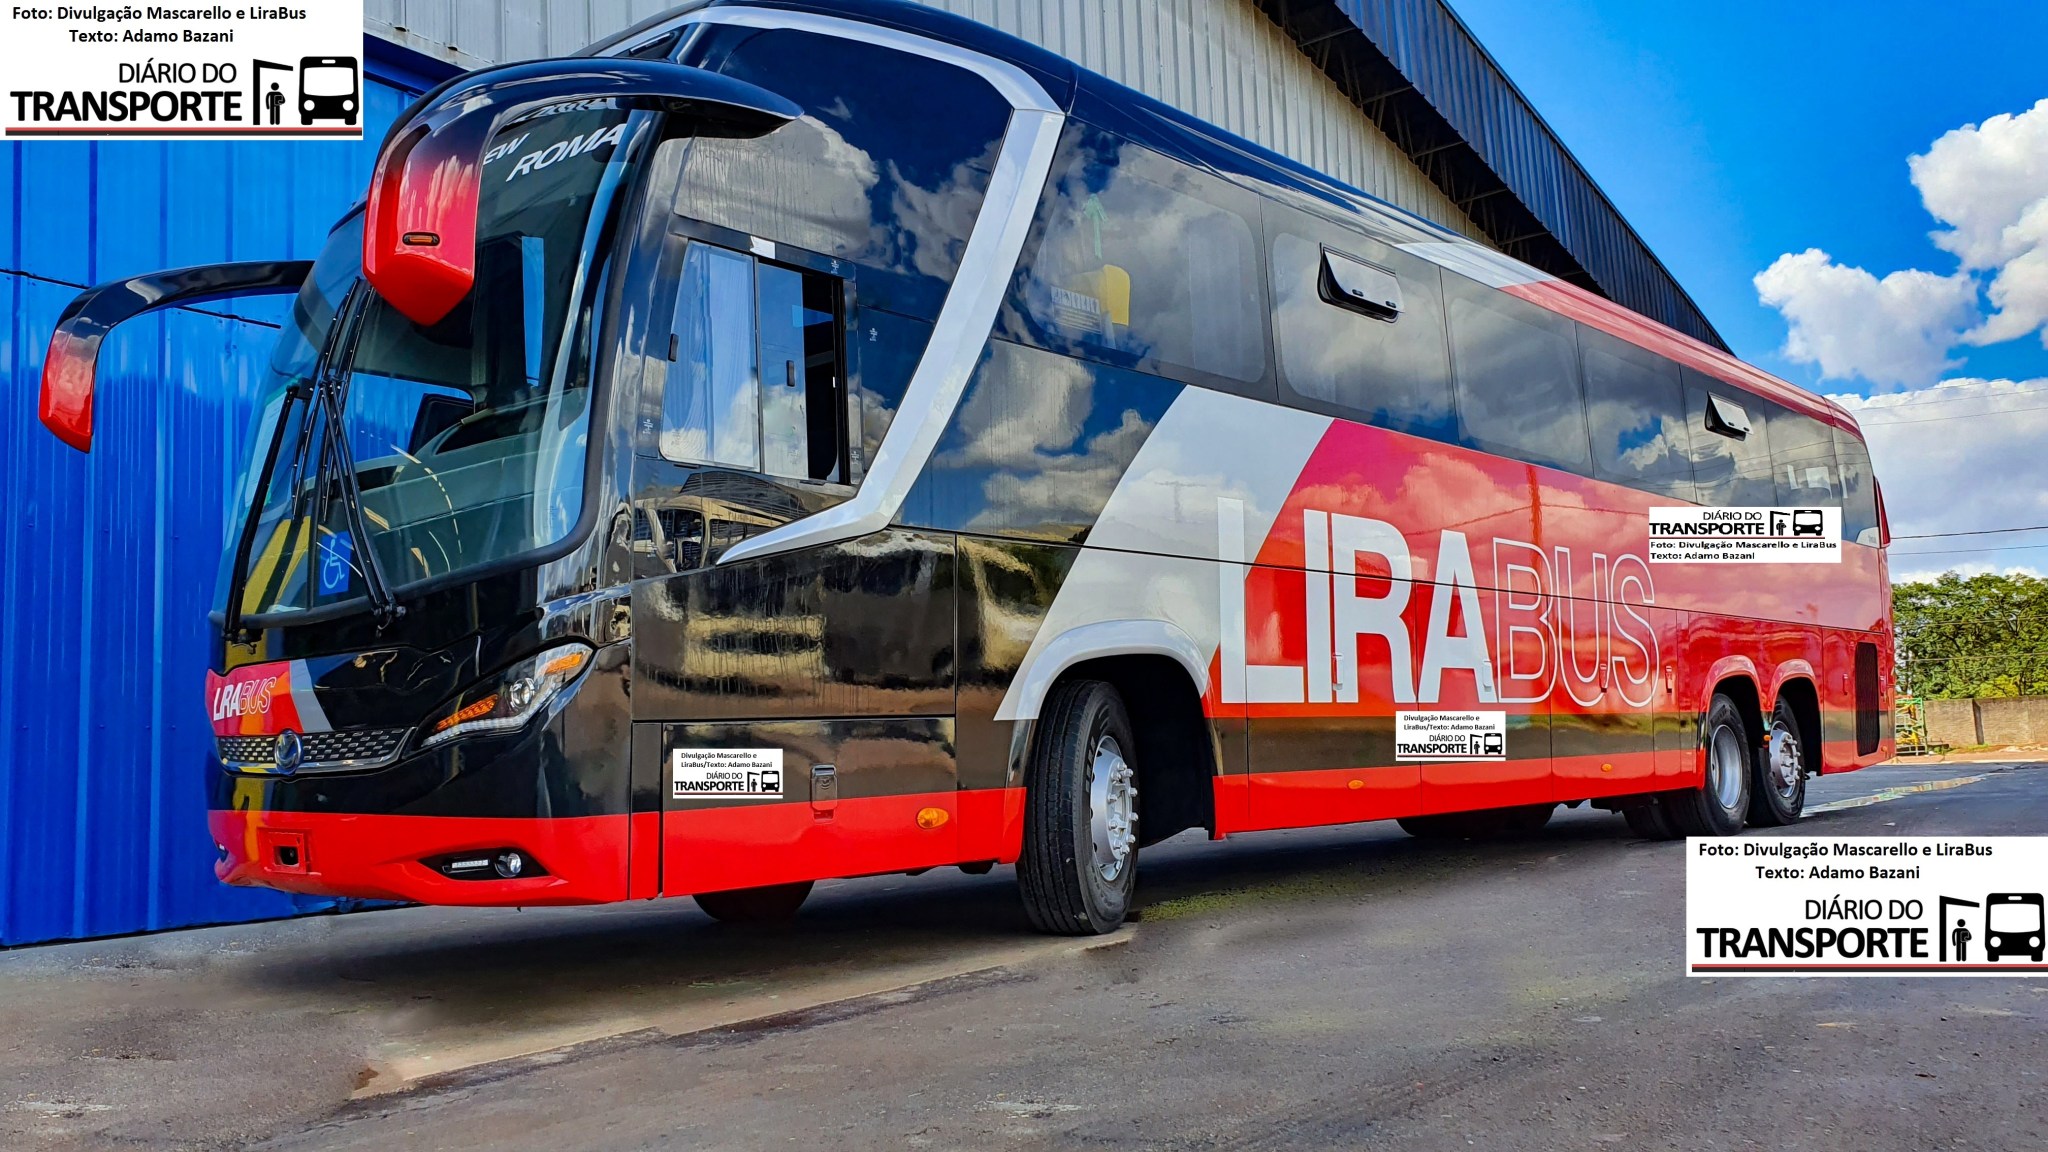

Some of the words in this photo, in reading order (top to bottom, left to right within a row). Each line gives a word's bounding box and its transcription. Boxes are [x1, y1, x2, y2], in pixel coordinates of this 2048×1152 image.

[482, 132, 531, 166] EW
[505, 123, 627, 183] ROMA
[1217, 496, 1662, 708] LIRABUS
